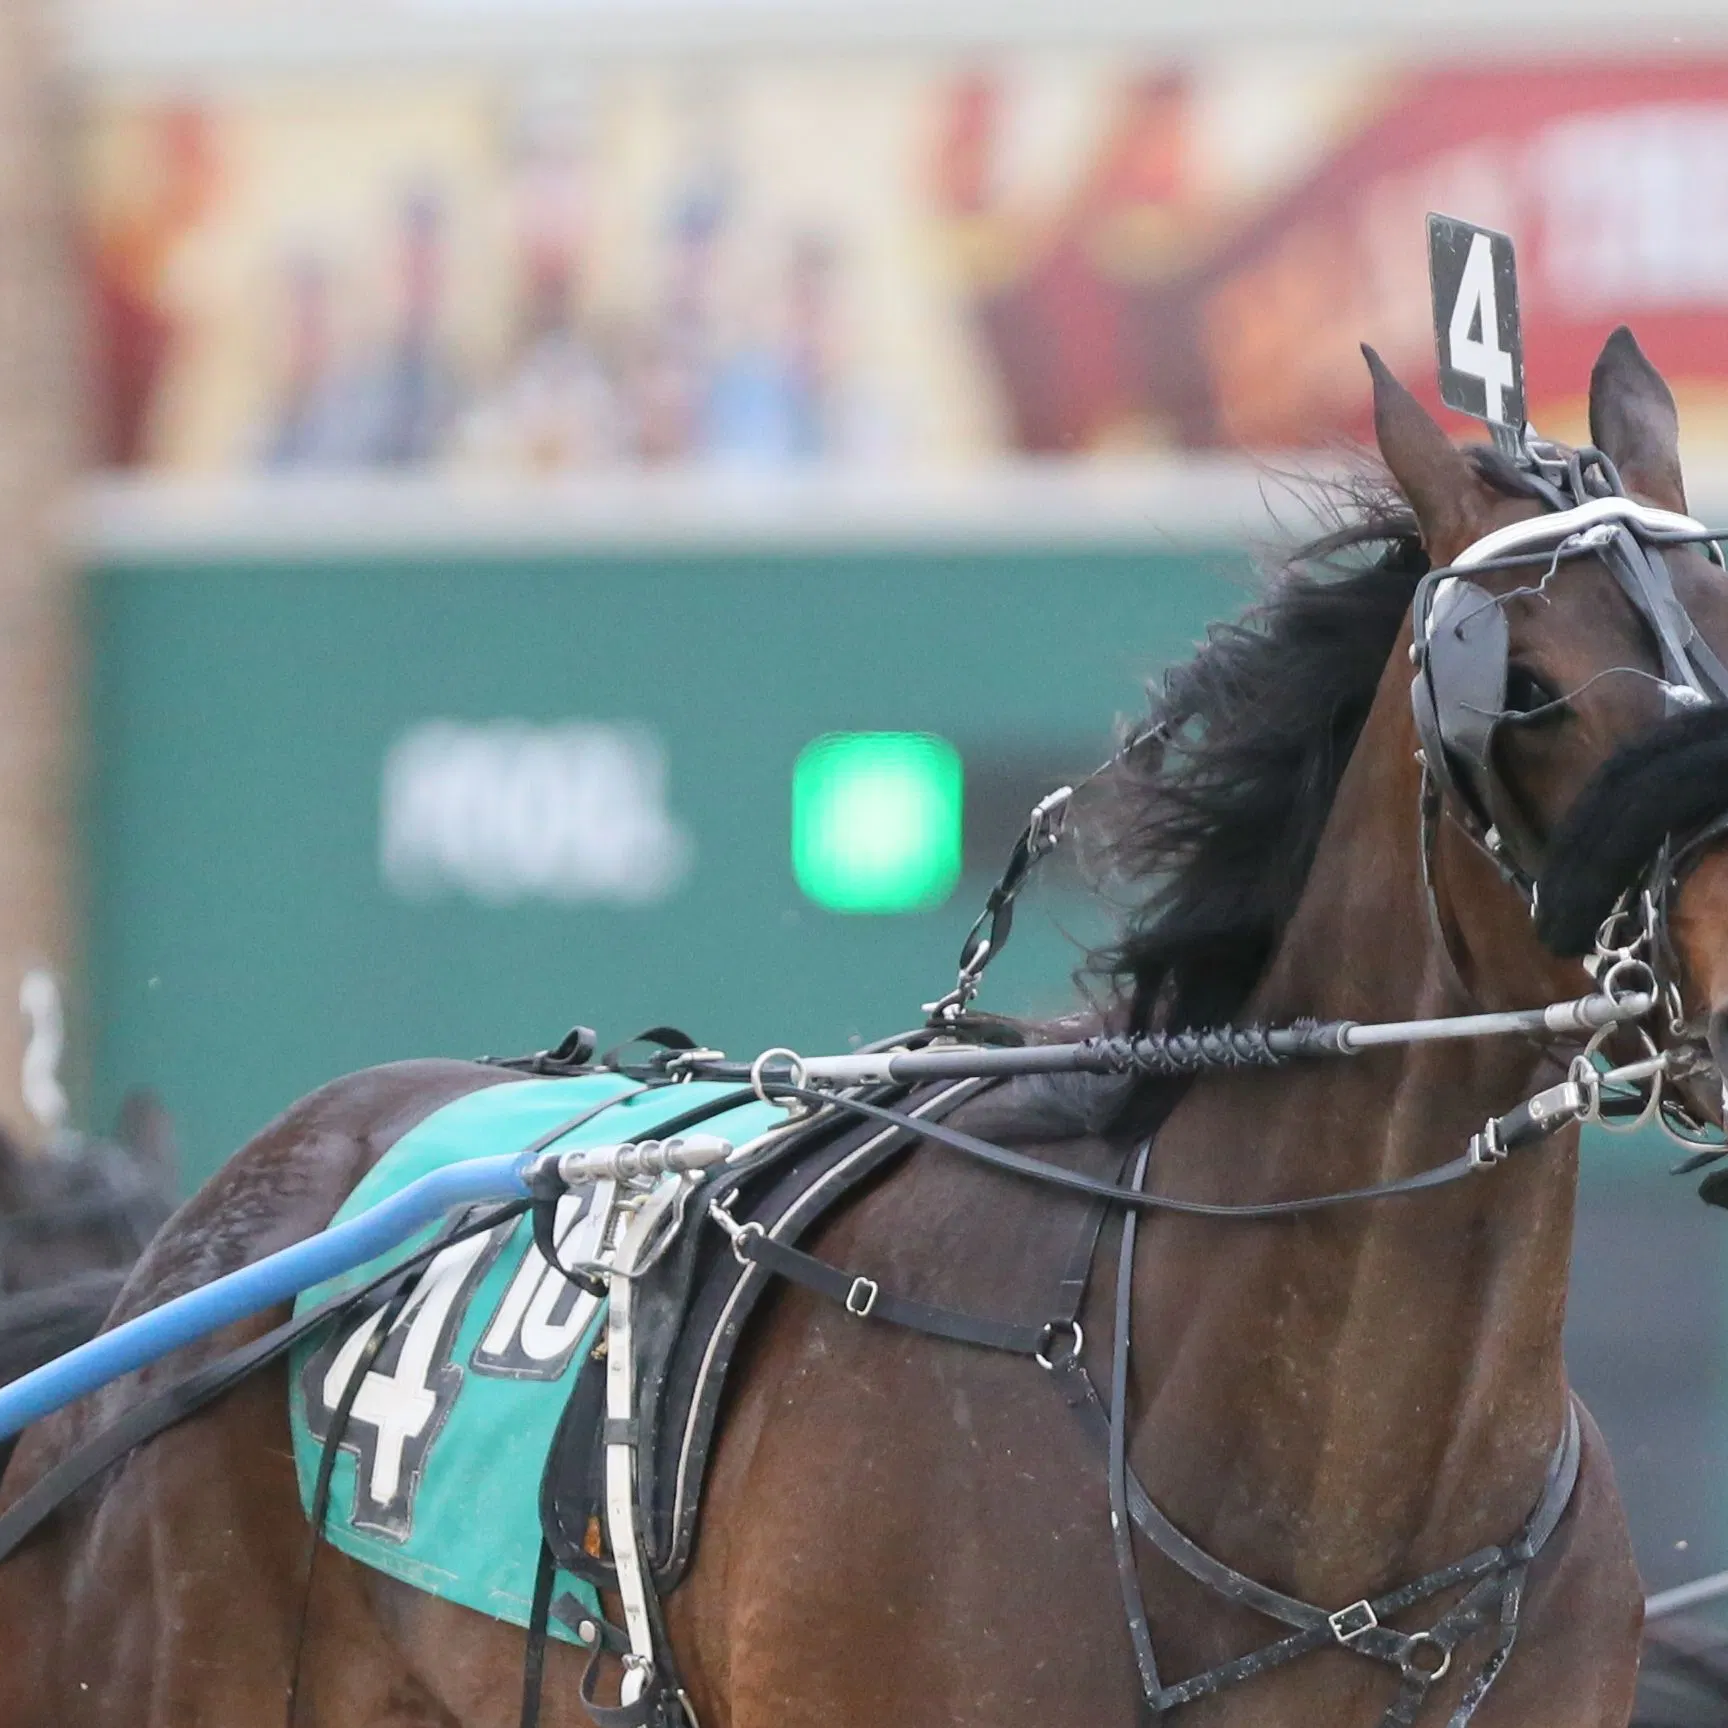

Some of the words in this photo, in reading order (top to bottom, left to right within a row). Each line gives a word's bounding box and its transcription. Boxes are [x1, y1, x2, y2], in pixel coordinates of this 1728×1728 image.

[1448, 232, 1514, 425] 4
[322, 1210, 492, 1506] 4
[480, 1192, 616, 1361] 10
